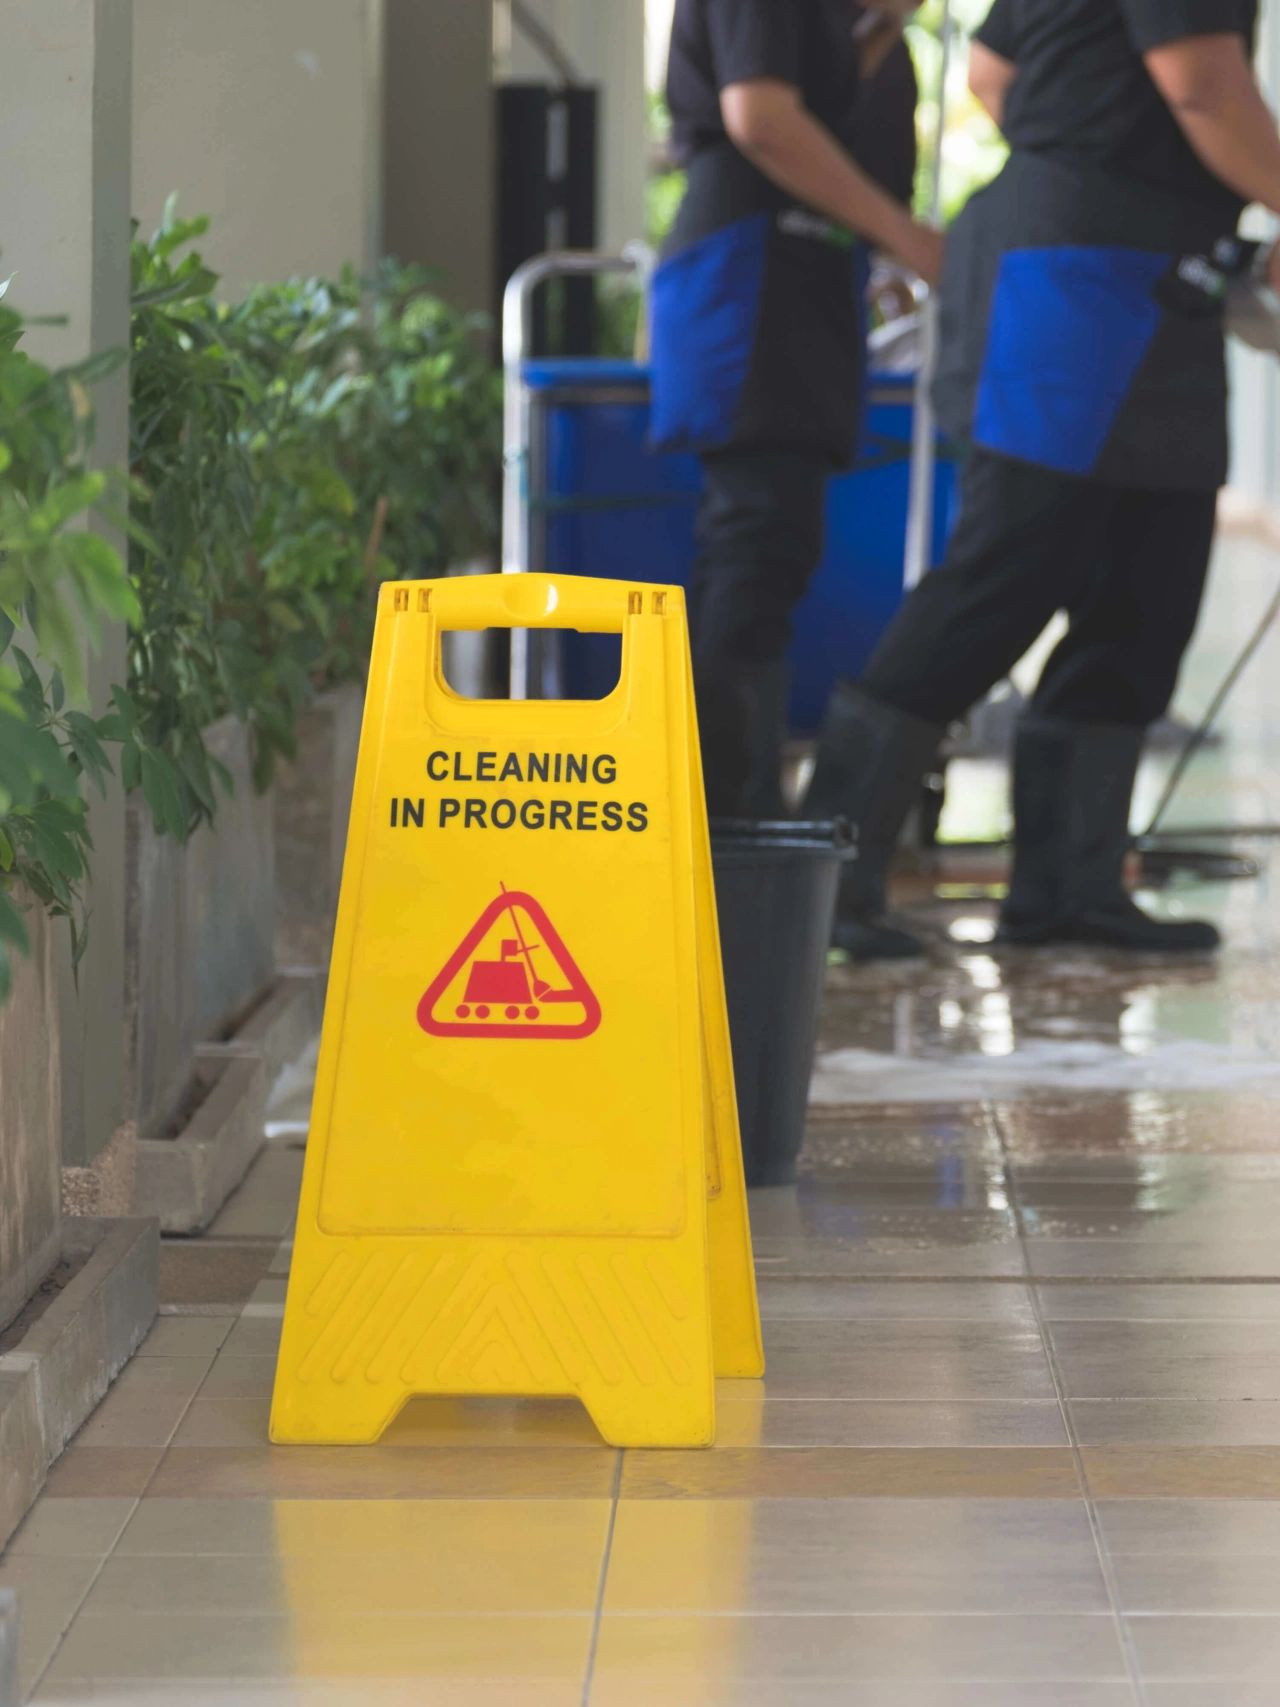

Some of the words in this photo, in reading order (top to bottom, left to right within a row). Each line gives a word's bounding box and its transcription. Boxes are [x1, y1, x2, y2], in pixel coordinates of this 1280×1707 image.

[426, 751, 617, 784] CLEANING
[390, 798, 425, 828] IN
[439, 799, 649, 832] PROGRESS
